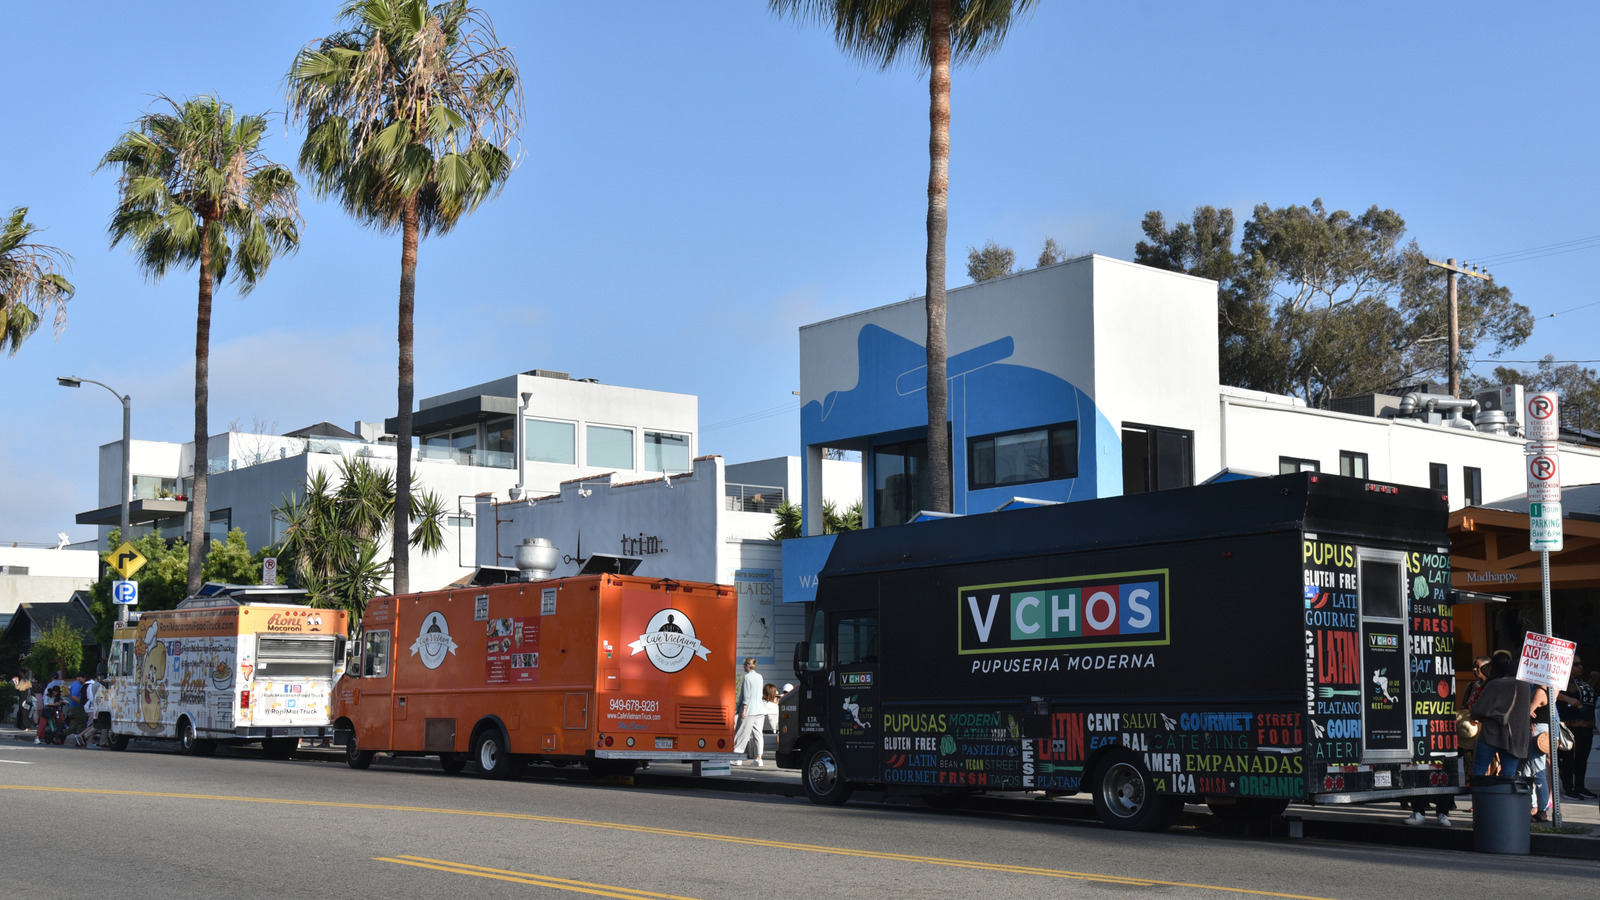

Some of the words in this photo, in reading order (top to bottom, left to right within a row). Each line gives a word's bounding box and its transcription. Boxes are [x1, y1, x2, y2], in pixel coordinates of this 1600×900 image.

[1532, 519, 1560, 529] PARKING
[1303, 540, 1357, 569] PUPUS
[1304, 569, 1335, 588] GLUTEN
[1467, 571, 1518, 583] Madhappy.
[736, 582, 773, 596] ILATES
[1413, 604, 1432, 614] BEAN
[160, 621, 234, 633] RoniMacaroniFoodTruck.com
[268, 613, 302, 627] Roni
[646, 634, 663, 644] Cafe
[663, 632, 697, 649] Vietnam
[1531, 641, 1567, 653] TEMPORARY
[1317, 629, 1361, 685] LATIN
[1523, 645, 1541, 660] NO
[1540, 651, 1571, 666] PARKING
[971, 657, 1060, 674] PUPUSERIA
[1067, 653, 1156, 671] MODERNA
[1434, 656, 1456, 675] RAL
[1526, 670, 1546, 679] FRIDAY
[264, 708, 318, 716] @RoniMacTruck
[609, 698, 660, 713] 949-678-9281
[1317, 701, 1362, 715] PLATANO
[1415, 701, 1457, 716] REVUEL
[884, 714, 947, 733] PUPUSAS
[948, 713, 1001, 727] MODERN
[1087, 713, 1120, 732] CENT
[1122, 713, 1157, 729] SALVI
[1181, 712, 1254, 731] GOURMET
[1257, 713, 1301, 727] STREET
[1430, 720, 1457, 734] STREET
[1326, 719, 1361, 739] GOUR
[884, 737, 911, 751] GLUTEN
[915, 738, 937, 751] FREE
[1090, 736, 1117, 750] EAT
[1122, 733, 1149, 752] RAL
[1154, 734, 1249, 750] CATERING
[1258, 729, 1303, 745] FOOD
[1430, 734, 1458, 751] FOOD
[908, 755, 938, 768] LATIN
[939, 759, 958, 769] BEAN
[965, 758, 984, 771] VEGAN
[985, 759, 1020, 771] STREET
[1186, 754, 1304, 774] EMPANADAS
[884, 771, 938, 784] GOURMET
[939, 771, 987, 785] FRESH
[989, 774, 1020, 786] TACOS
[1172, 773, 1196, 793] ICA
[1200, 777, 1227, 793] SALSA
[1240, 775, 1304, 798] ORGANIC
